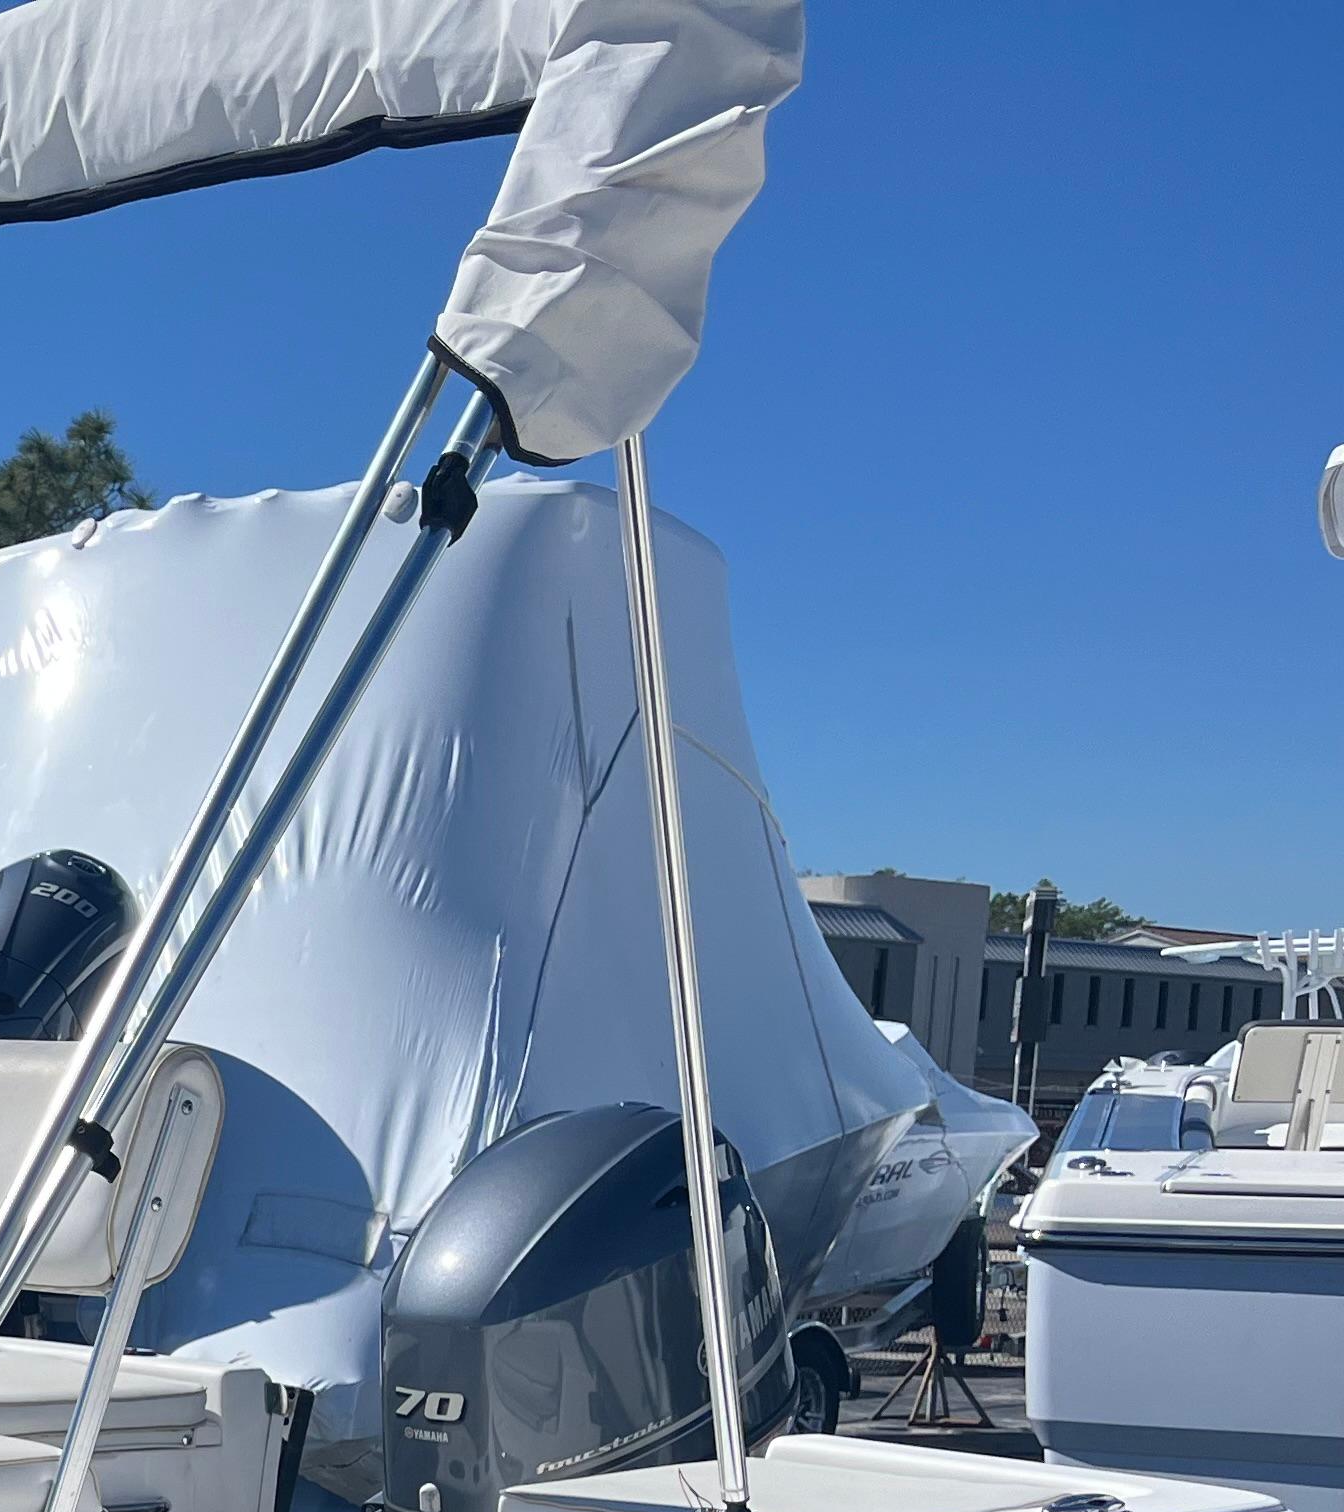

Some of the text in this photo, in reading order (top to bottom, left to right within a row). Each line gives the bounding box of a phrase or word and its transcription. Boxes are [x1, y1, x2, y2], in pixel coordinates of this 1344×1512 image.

[30, 881, 99, 919] 200
[395, 1386, 465, 1421] 70
[413, 1429, 449, 1442] YAMAHA
